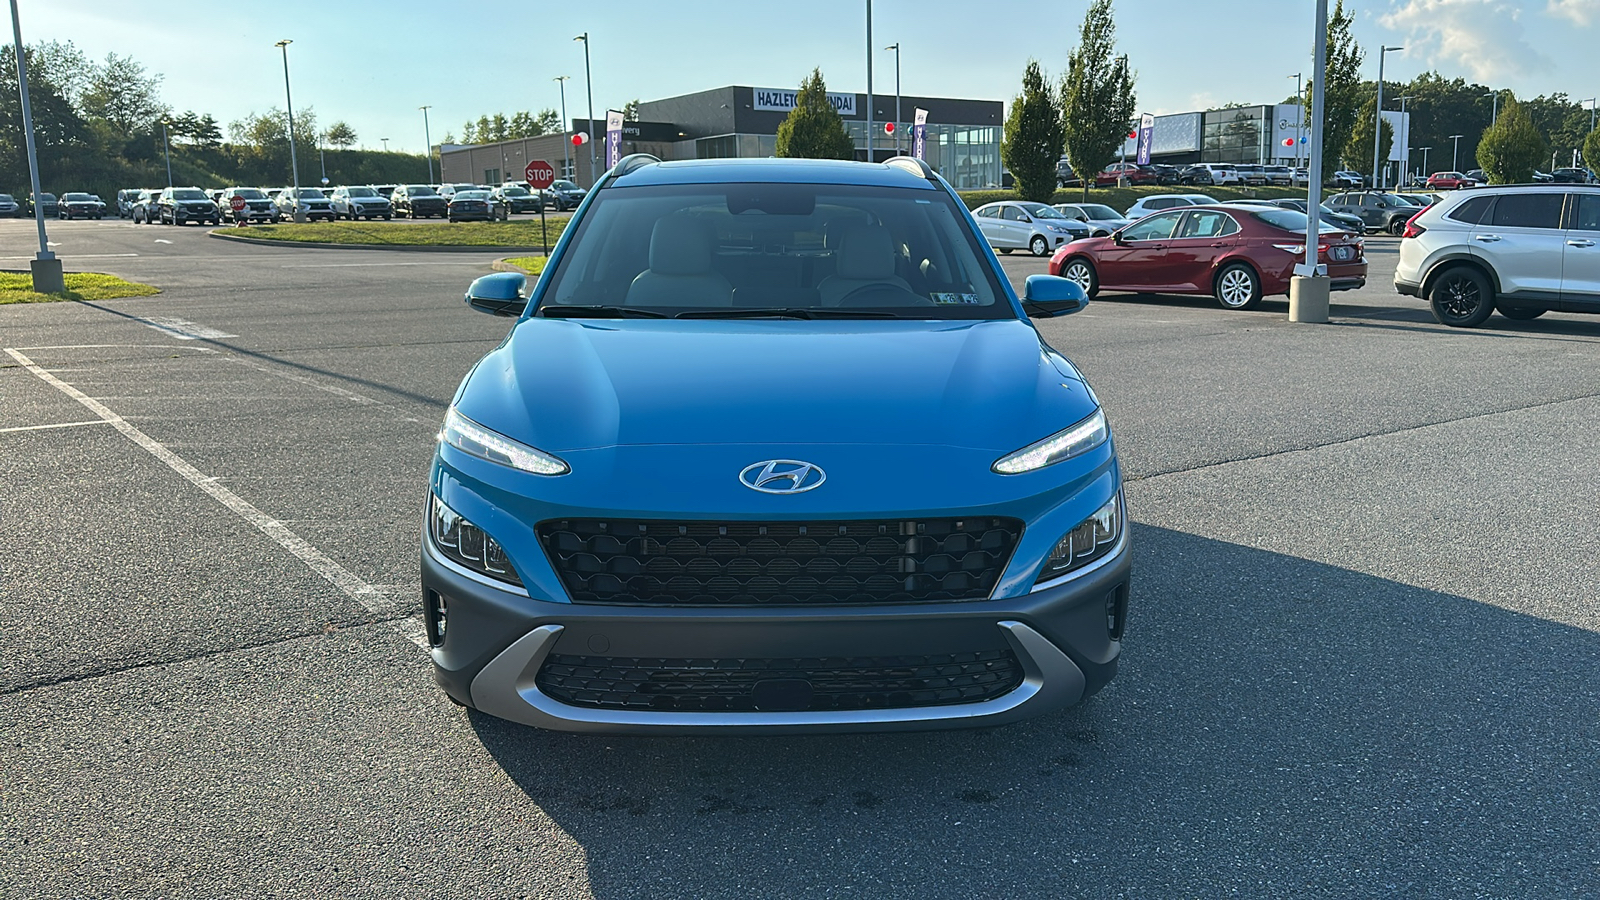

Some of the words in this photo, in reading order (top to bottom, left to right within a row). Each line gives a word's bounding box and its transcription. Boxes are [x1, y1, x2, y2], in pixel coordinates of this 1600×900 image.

[758, 92, 798, 107] HAZLETO
[527, 169, 553, 181] STOP
[231, 200, 245, 208] STOP
